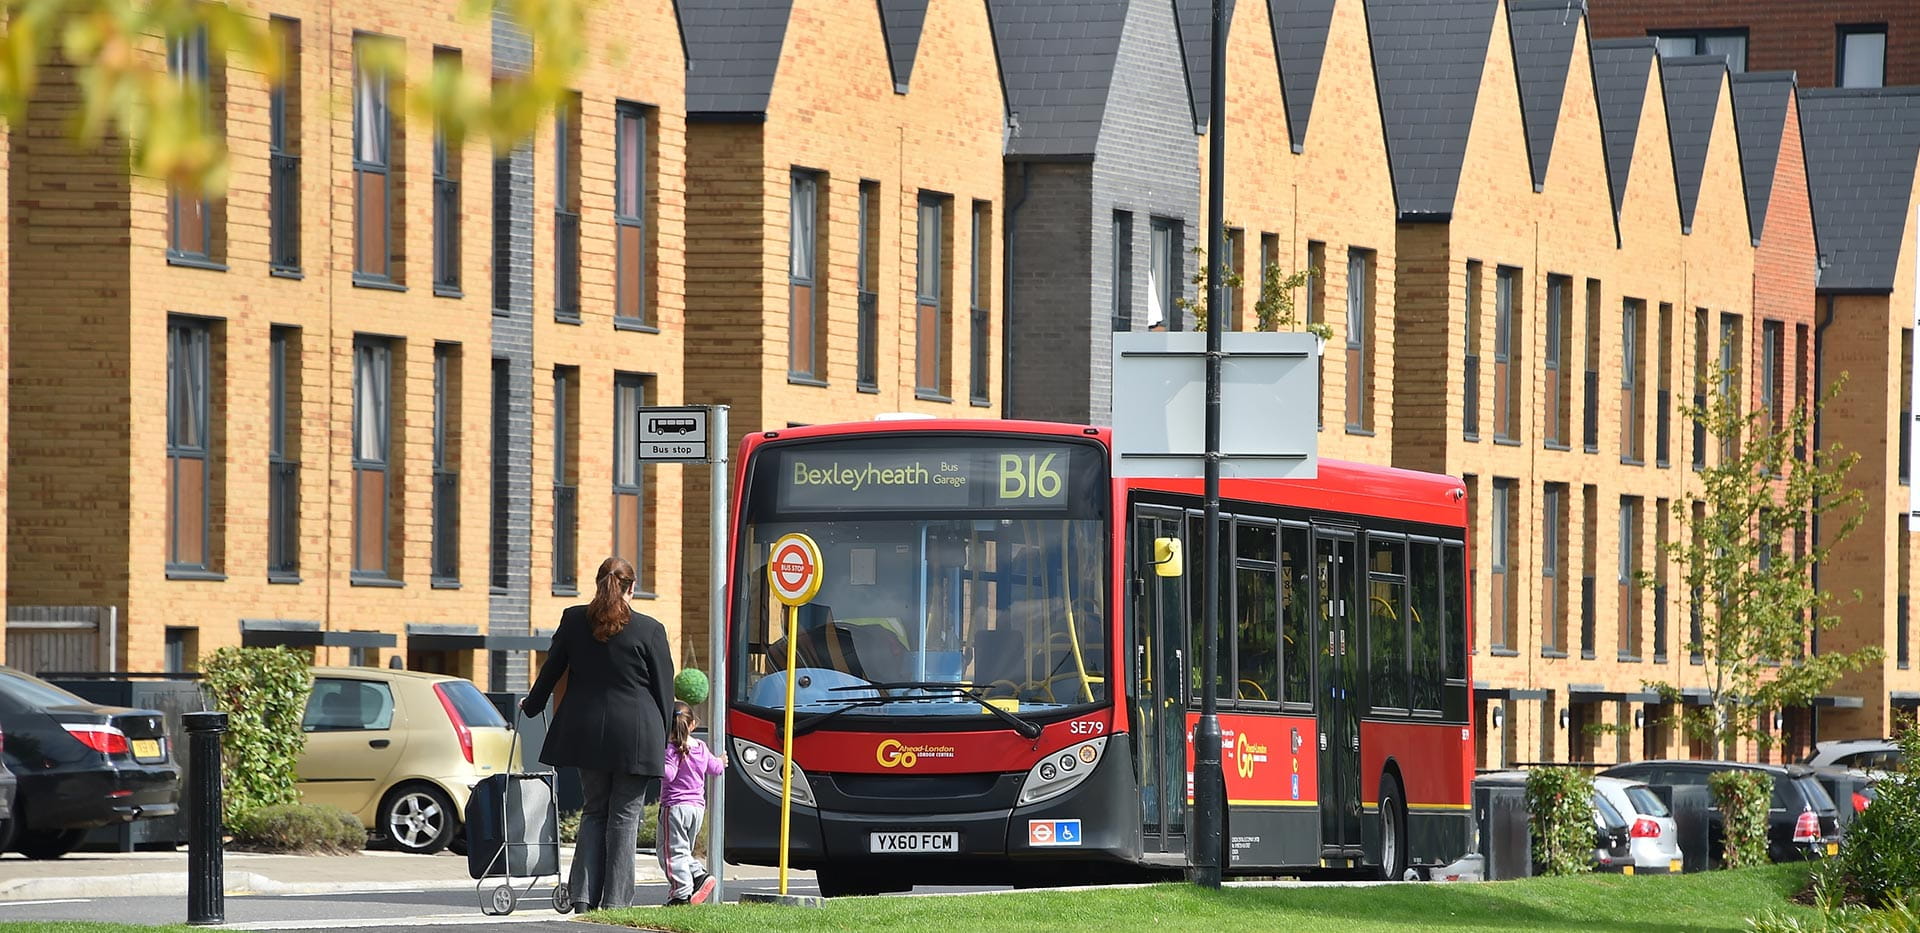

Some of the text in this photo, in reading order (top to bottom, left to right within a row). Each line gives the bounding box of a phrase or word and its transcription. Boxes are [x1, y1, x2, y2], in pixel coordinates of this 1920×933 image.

[673, 446, 692, 454] stop
[941, 462, 958, 472] Bus
[794, 462, 928, 491] Bexleyheath
[933, 474, 966, 487] Garage
[1000, 453, 1061, 498] B16
[791, 564, 804, 572] STOP
[1070, 721, 1104, 734] SE79
[876, 739, 917, 768] Go
[1237, 732, 1254, 778] Go
[878, 835, 952, 849] YX60 FCM
